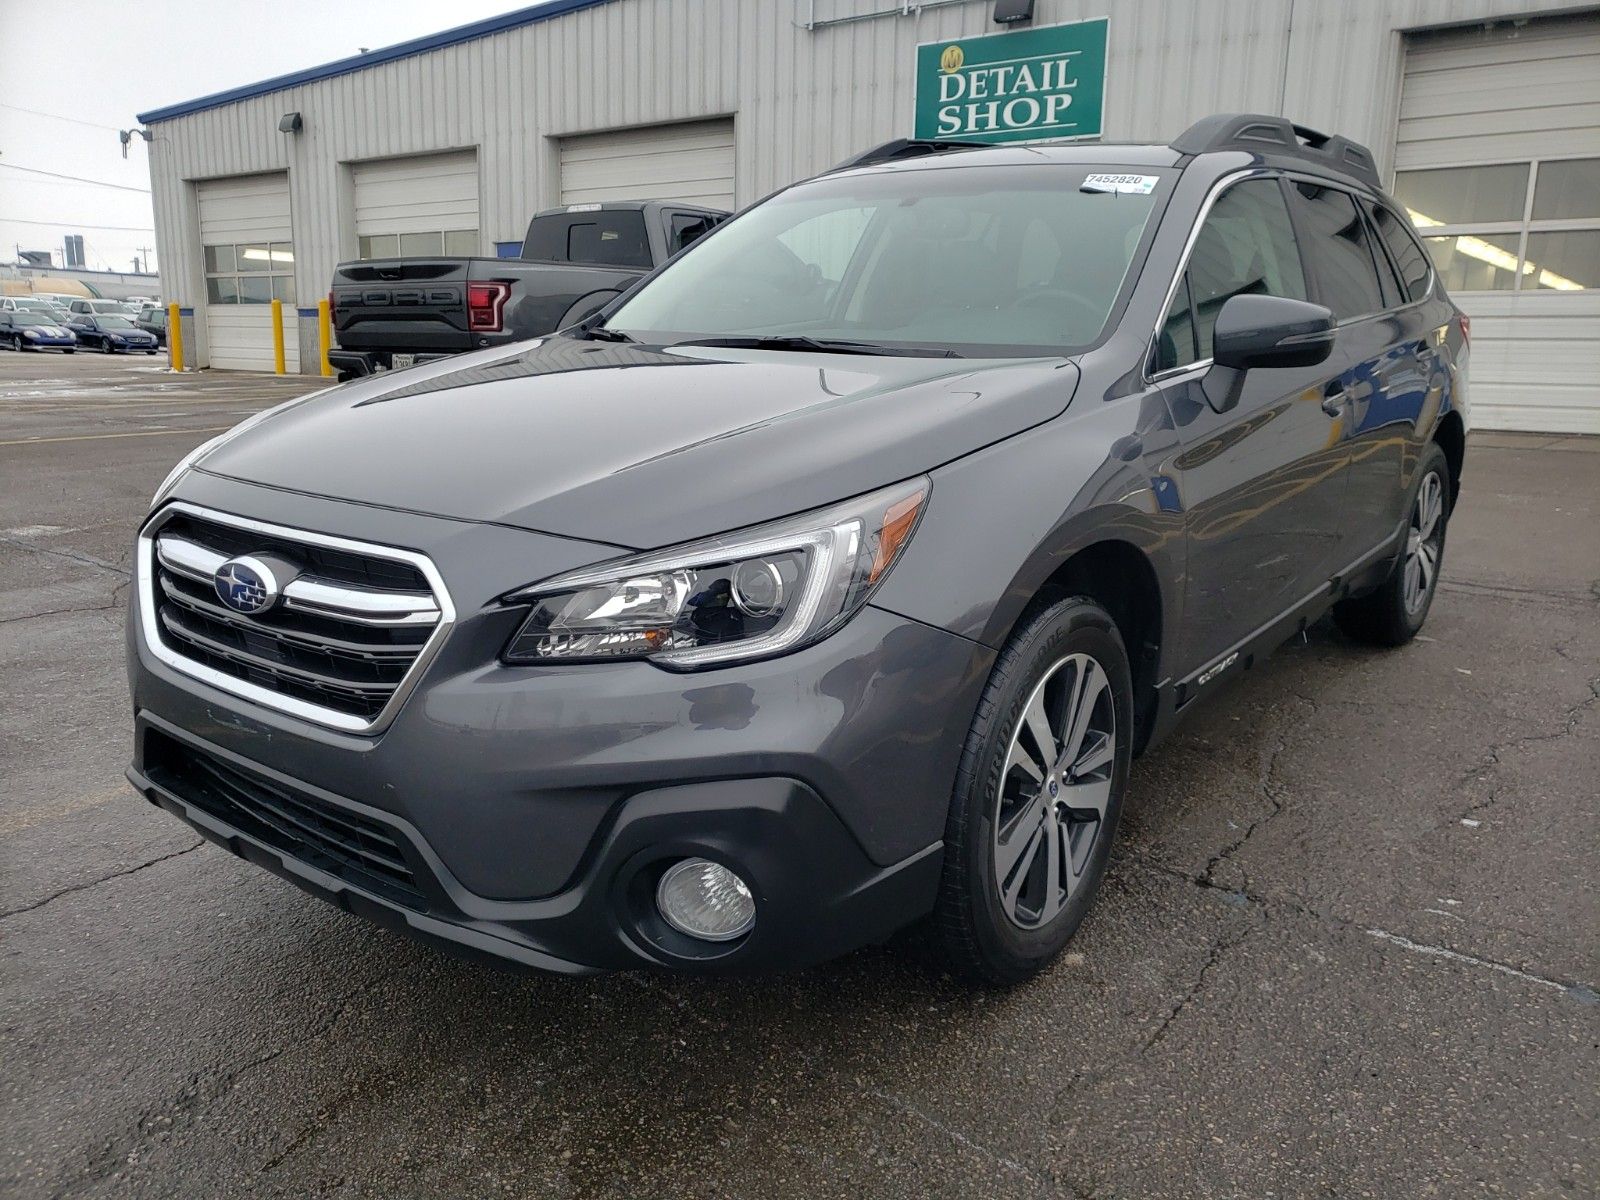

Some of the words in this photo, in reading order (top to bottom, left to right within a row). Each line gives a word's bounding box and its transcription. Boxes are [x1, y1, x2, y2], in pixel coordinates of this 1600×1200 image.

[938, 59, 1078, 102] DETAIL
[937, 94, 1073, 134] SHOP
[1088, 175, 1143, 184] 7452820
[336, 287, 463, 307] FORD
